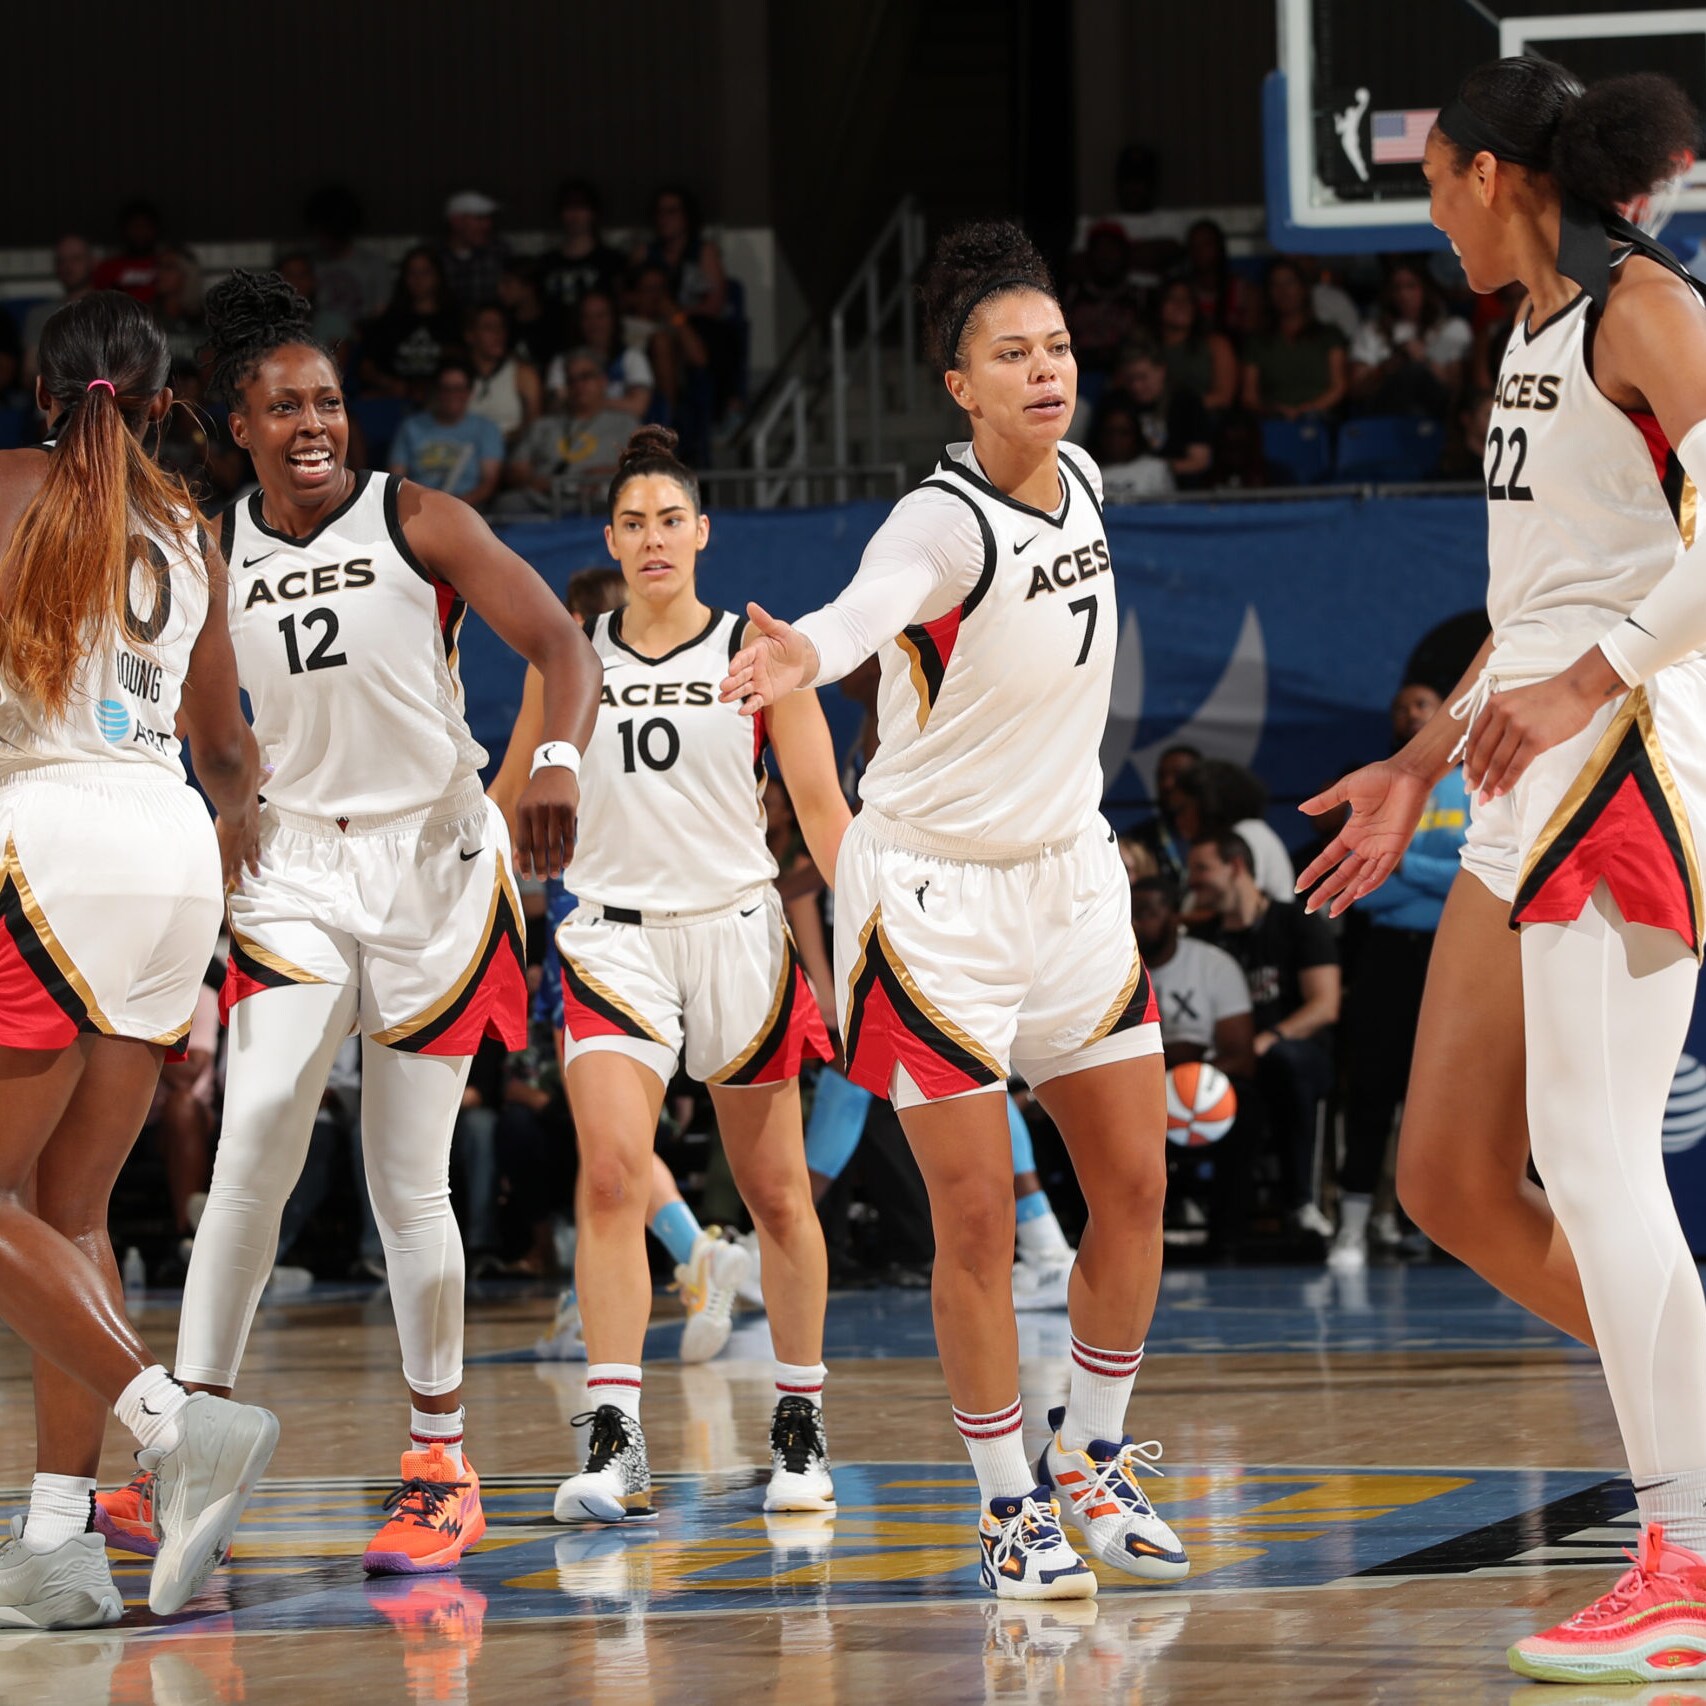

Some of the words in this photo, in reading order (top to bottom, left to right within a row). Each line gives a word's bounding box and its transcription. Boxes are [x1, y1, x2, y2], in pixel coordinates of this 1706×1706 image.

[1488, 426, 1534, 501] 22
[244, 558, 376, 611] ACES
[1024, 539, 1110, 602] ACES
[278, 607, 348, 675] 12
[1067, 594, 1098, 667] 7
[600, 681, 714, 707] ACES
[617, 717, 680, 773] 10
